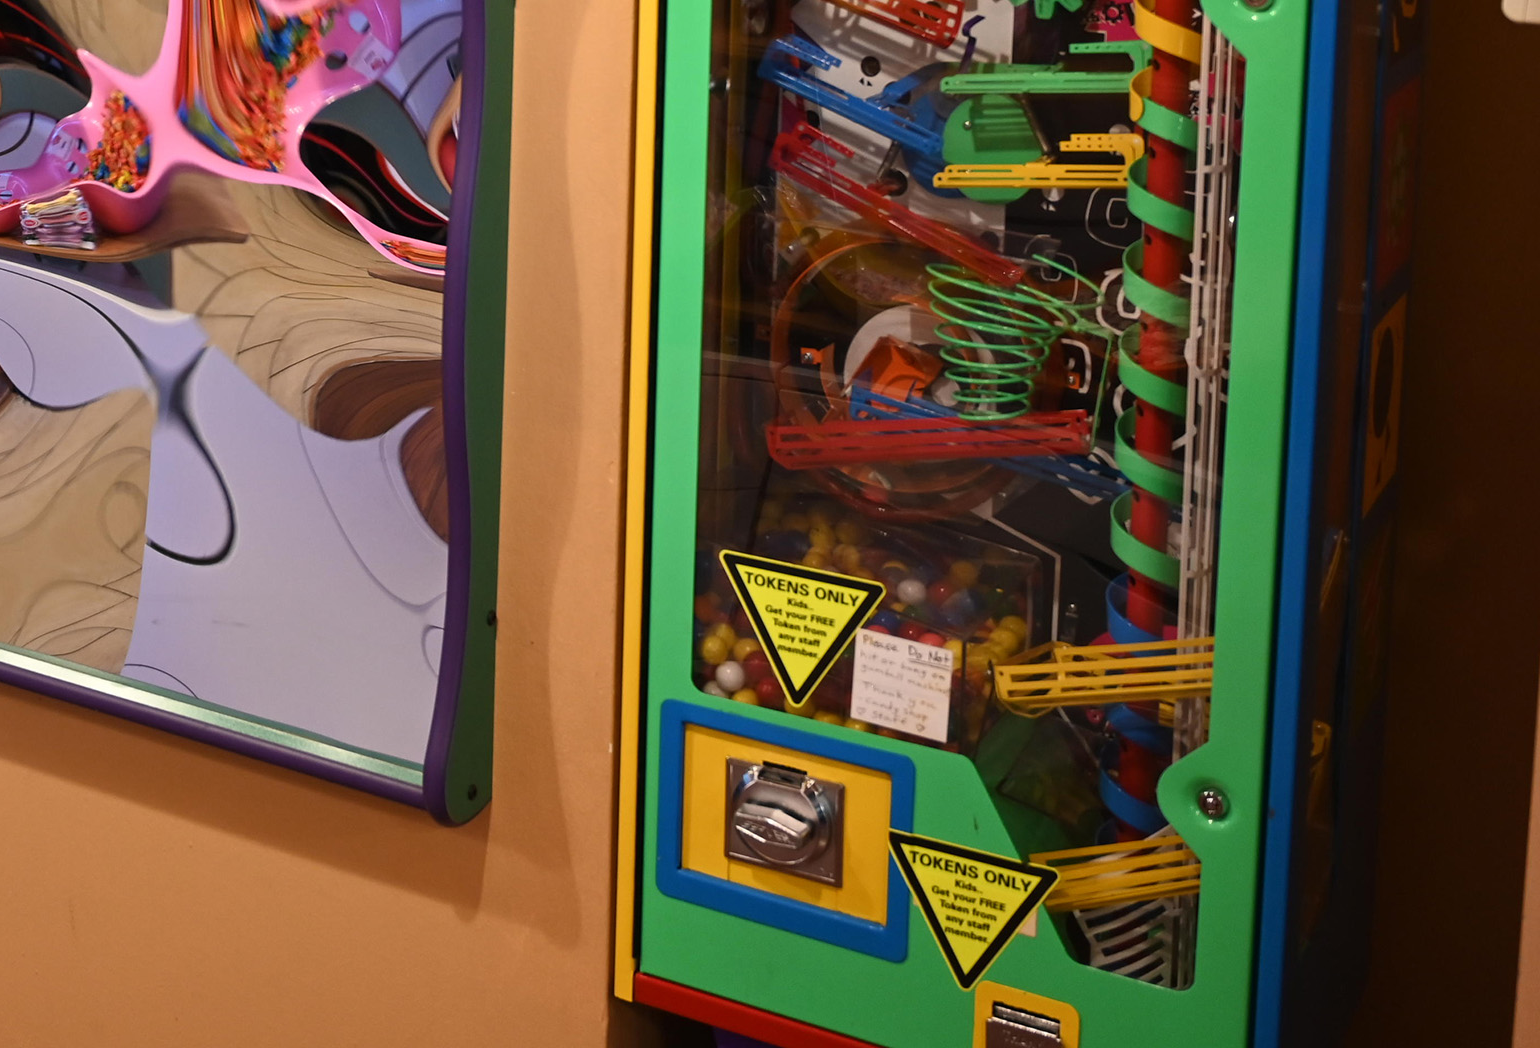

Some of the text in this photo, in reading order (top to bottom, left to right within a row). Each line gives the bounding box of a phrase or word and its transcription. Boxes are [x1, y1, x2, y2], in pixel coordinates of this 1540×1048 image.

[744, 571, 860, 607] TOKENS ONLY
[765, 605, 836, 627] Get your FREE
[773, 618, 827, 638] Token from
[778, 633, 821, 648] any staff
[908, 645, 923, 659] Do
[927, 652, 950, 665] Not
[909, 850, 1032, 893] TOKENS ONLY
[931, 885, 1006, 912] Get your FREE
[940, 899, 997, 922] Token from
[945, 914, 991, 932] any staff
